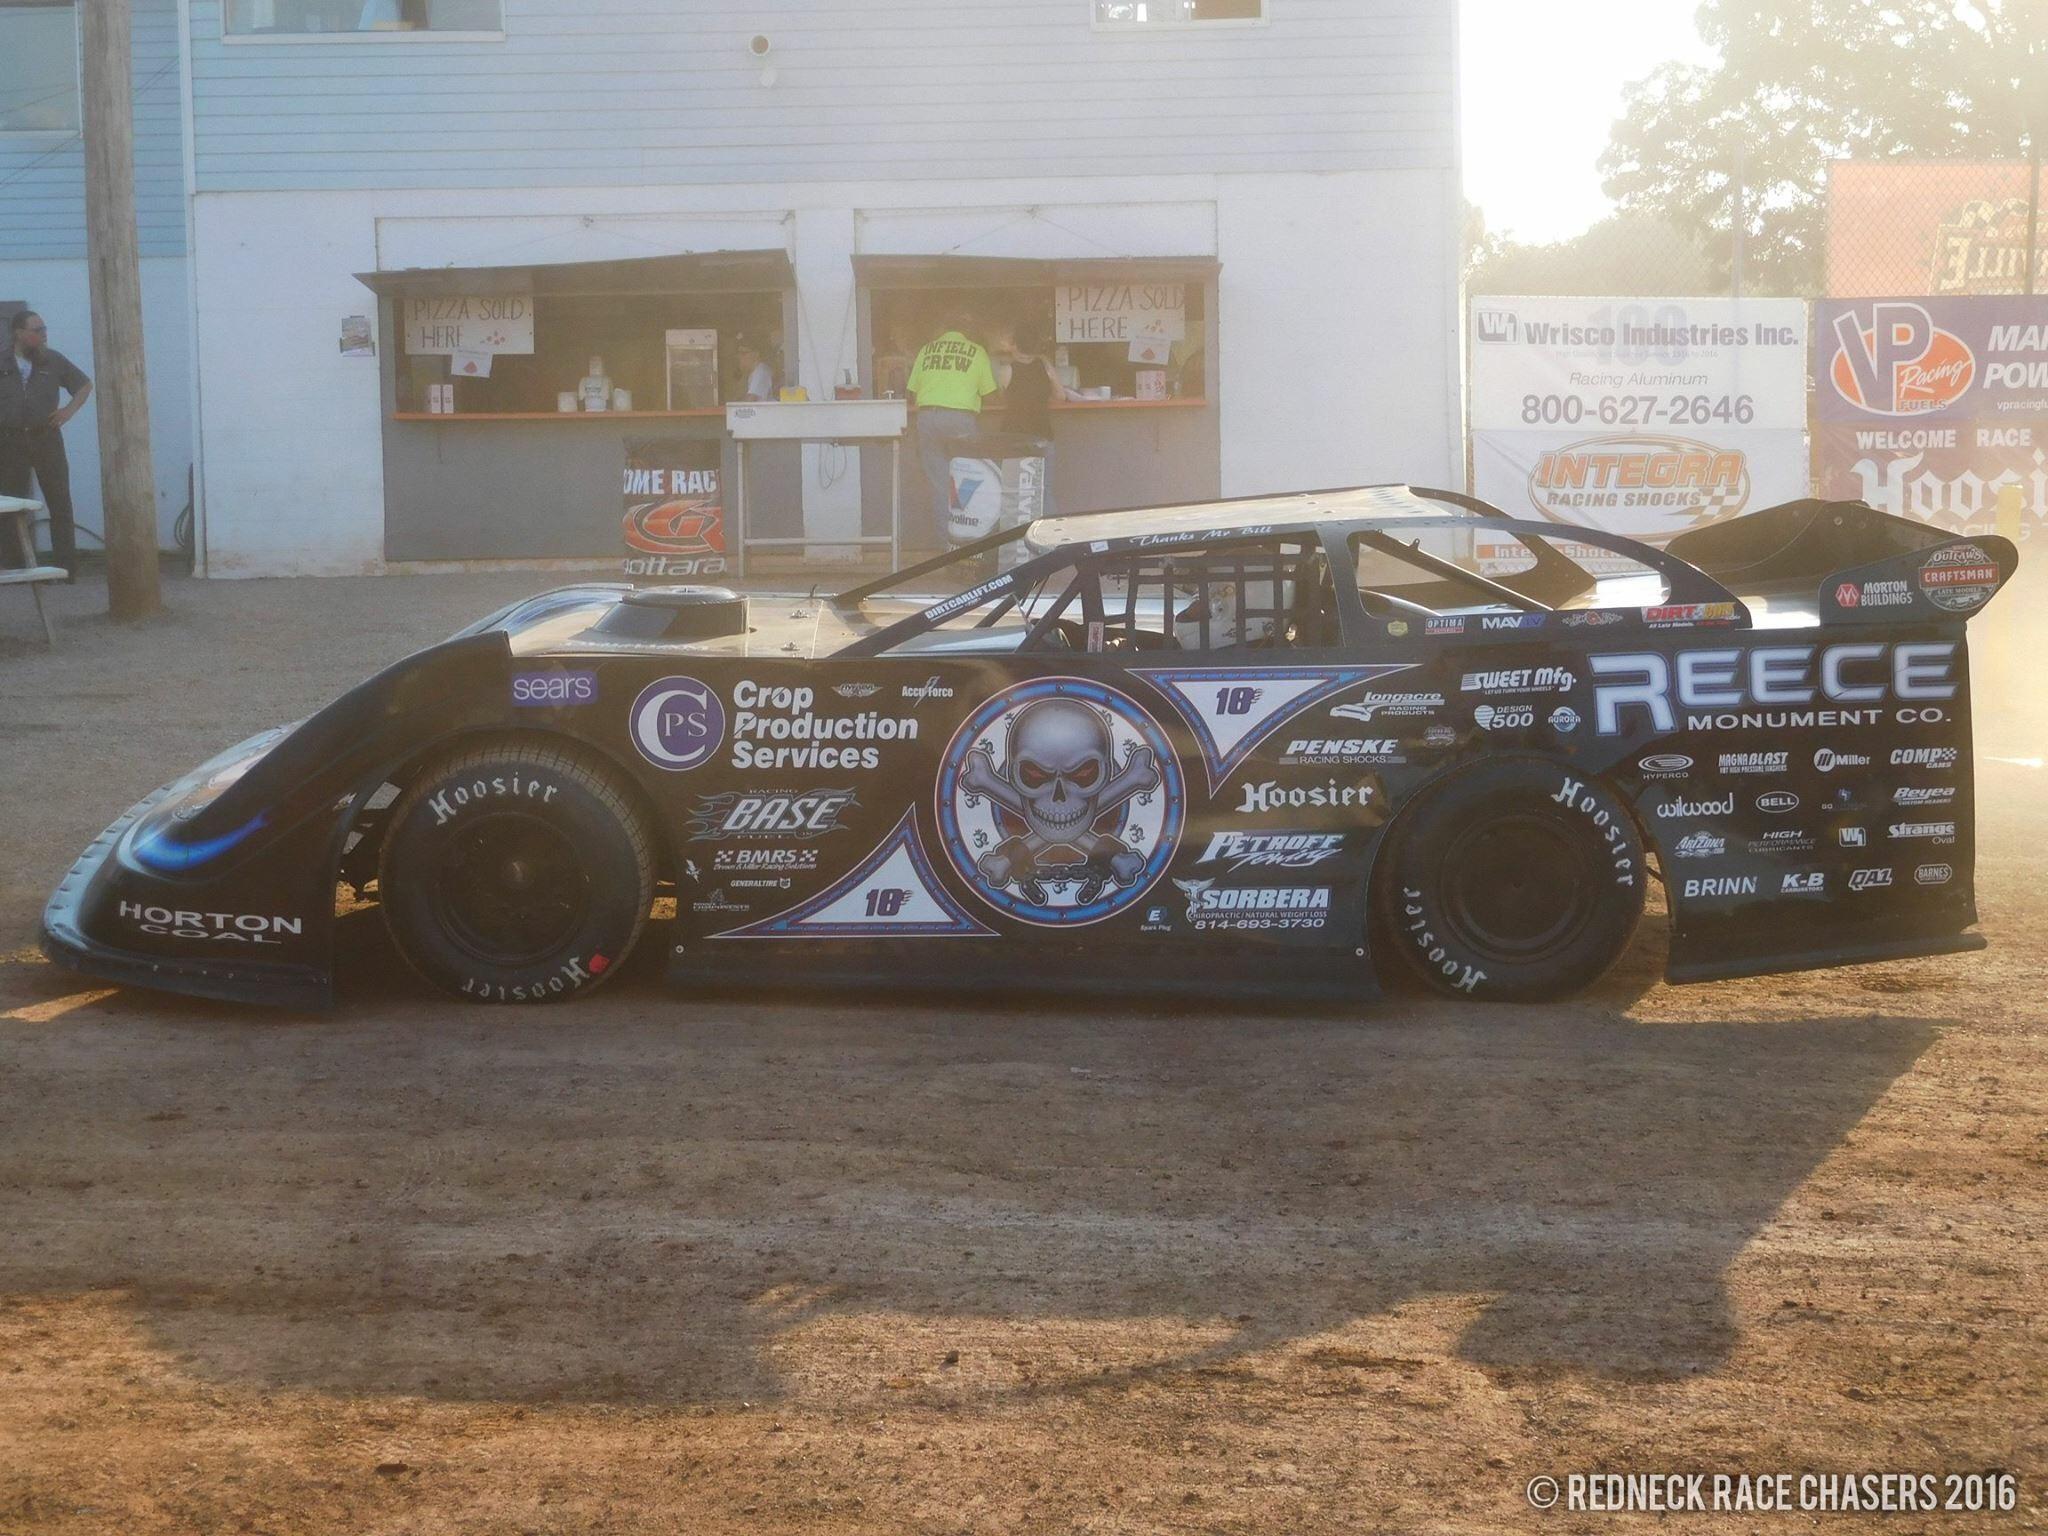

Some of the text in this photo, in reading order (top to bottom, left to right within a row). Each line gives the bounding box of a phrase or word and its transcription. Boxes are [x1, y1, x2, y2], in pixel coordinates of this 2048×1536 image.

[1069, 284, 1183, 312] PIZZA SOLD
[413, 299, 525, 320] PIZZA SOLD
[1070, 316, 1128, 339] HERE
[1524, 322, 1799, 346] Wrisco Industries Inc.
[1988, 325, 2048, 352] MA
[924, 340, 976, 357] INFIELD
[1834, 303, 1933, 411] VP
[922, 354, 973, 373] CREW
[1569, 372, 1708, 388] Racing Aluminum
[1899, 358, 1973, 394] Racing
[1521, 394, 1754, 425] 800-627-2646
[1900, 399, 1947, 411] FUELS
[1855, 428, 2032, 450] WELCOME RACE
[671, 470, 720, 494] RAC
[1536, 453, 1746, 489] INTEGRA
[1546, 491, 1701, 507] RACING SHOCKS
[1130, 532, 1195, 547] Thanks
[1241, 525, 1273, 535] Bill
[1934, 548, 1984, 562] OUTLAWS
[1924, 568, 1993, 583] CRAFTSMAN
[924, 574, 1014, 620] DIRTCARLIFT.COM
[1863, 580, 1908, 594] MORTON
[1861, 592, 1913, 607] BUILDINGS
[1427, 618, 1463, 629] OPTIMA
[513, 677, 592, 700] sears
[1461, 667, 1577, 691] SWEET Mfg.
[1588, 642, 1958, 735] REECE
[733, 680, 814, 715] Crop
[1216, 686, 1256, 715] 18
[1497, 704, 1533, 714] DESIGN
[1548, 715, 1581, 724] AURORA
[1688, 708, 1952, 731] MONUMENT CO.
[733, 711, 919, 740] Production
[1492, 713, 1534, 728] 500
[731, 740, 880, 769] Services
[1286, 739, 1399, 755] PENSKE
[1890, 748, 1940, 765] COMP
[1299, 755, 1386, 764] RACING SHOCKS
[1836, 754, 1871, 766] Miller
[1643, 771, 1689, 780] HYPERCO
[428, 772, 559, 826] Hoosier
[1234, 778, 1374, 813] Hoosier
[1760, 797, 1795, 807] BELL
[1893, 787, 1956, 800] Beyea
[722, 798, 847, 830] BASE
[1657, 792, 1734, 818] wilwood
[1551, 777, 1634, 887] Hoosier
[1763, 830, 1803, 840] HIGH
[1888, 822, 1955, 839] Strange
[1932, 836, 1955, 844] Oval
[736, 849, 797, 863] BMRS
[1195, 831, 1347, 864] PETROFF
[1227, 848, 1343, 873] Towing
[1782, 873, 1825, 888] K-B
[1848, 868, 1892, 891] QA1
[1918, 866, 1949, 878] BARNES
[1684, 876, 1758, 897] BRINN
[865, 888, 905, 917] 18
[1201, 888, 1330, 910] SORBERA
[119, 900, 302, 935] HORTON
[1195, 918, 1325, 930] 814-693-3730
[1280, 910, 1308, 919] WEIGHT
[1309, 910, 1327, 919] LOSS
[140, 924, 282, 944] COAL
[1403, 887, 1488, 993] Hoosier
[461, 956, 590, 1000] Hoosier
